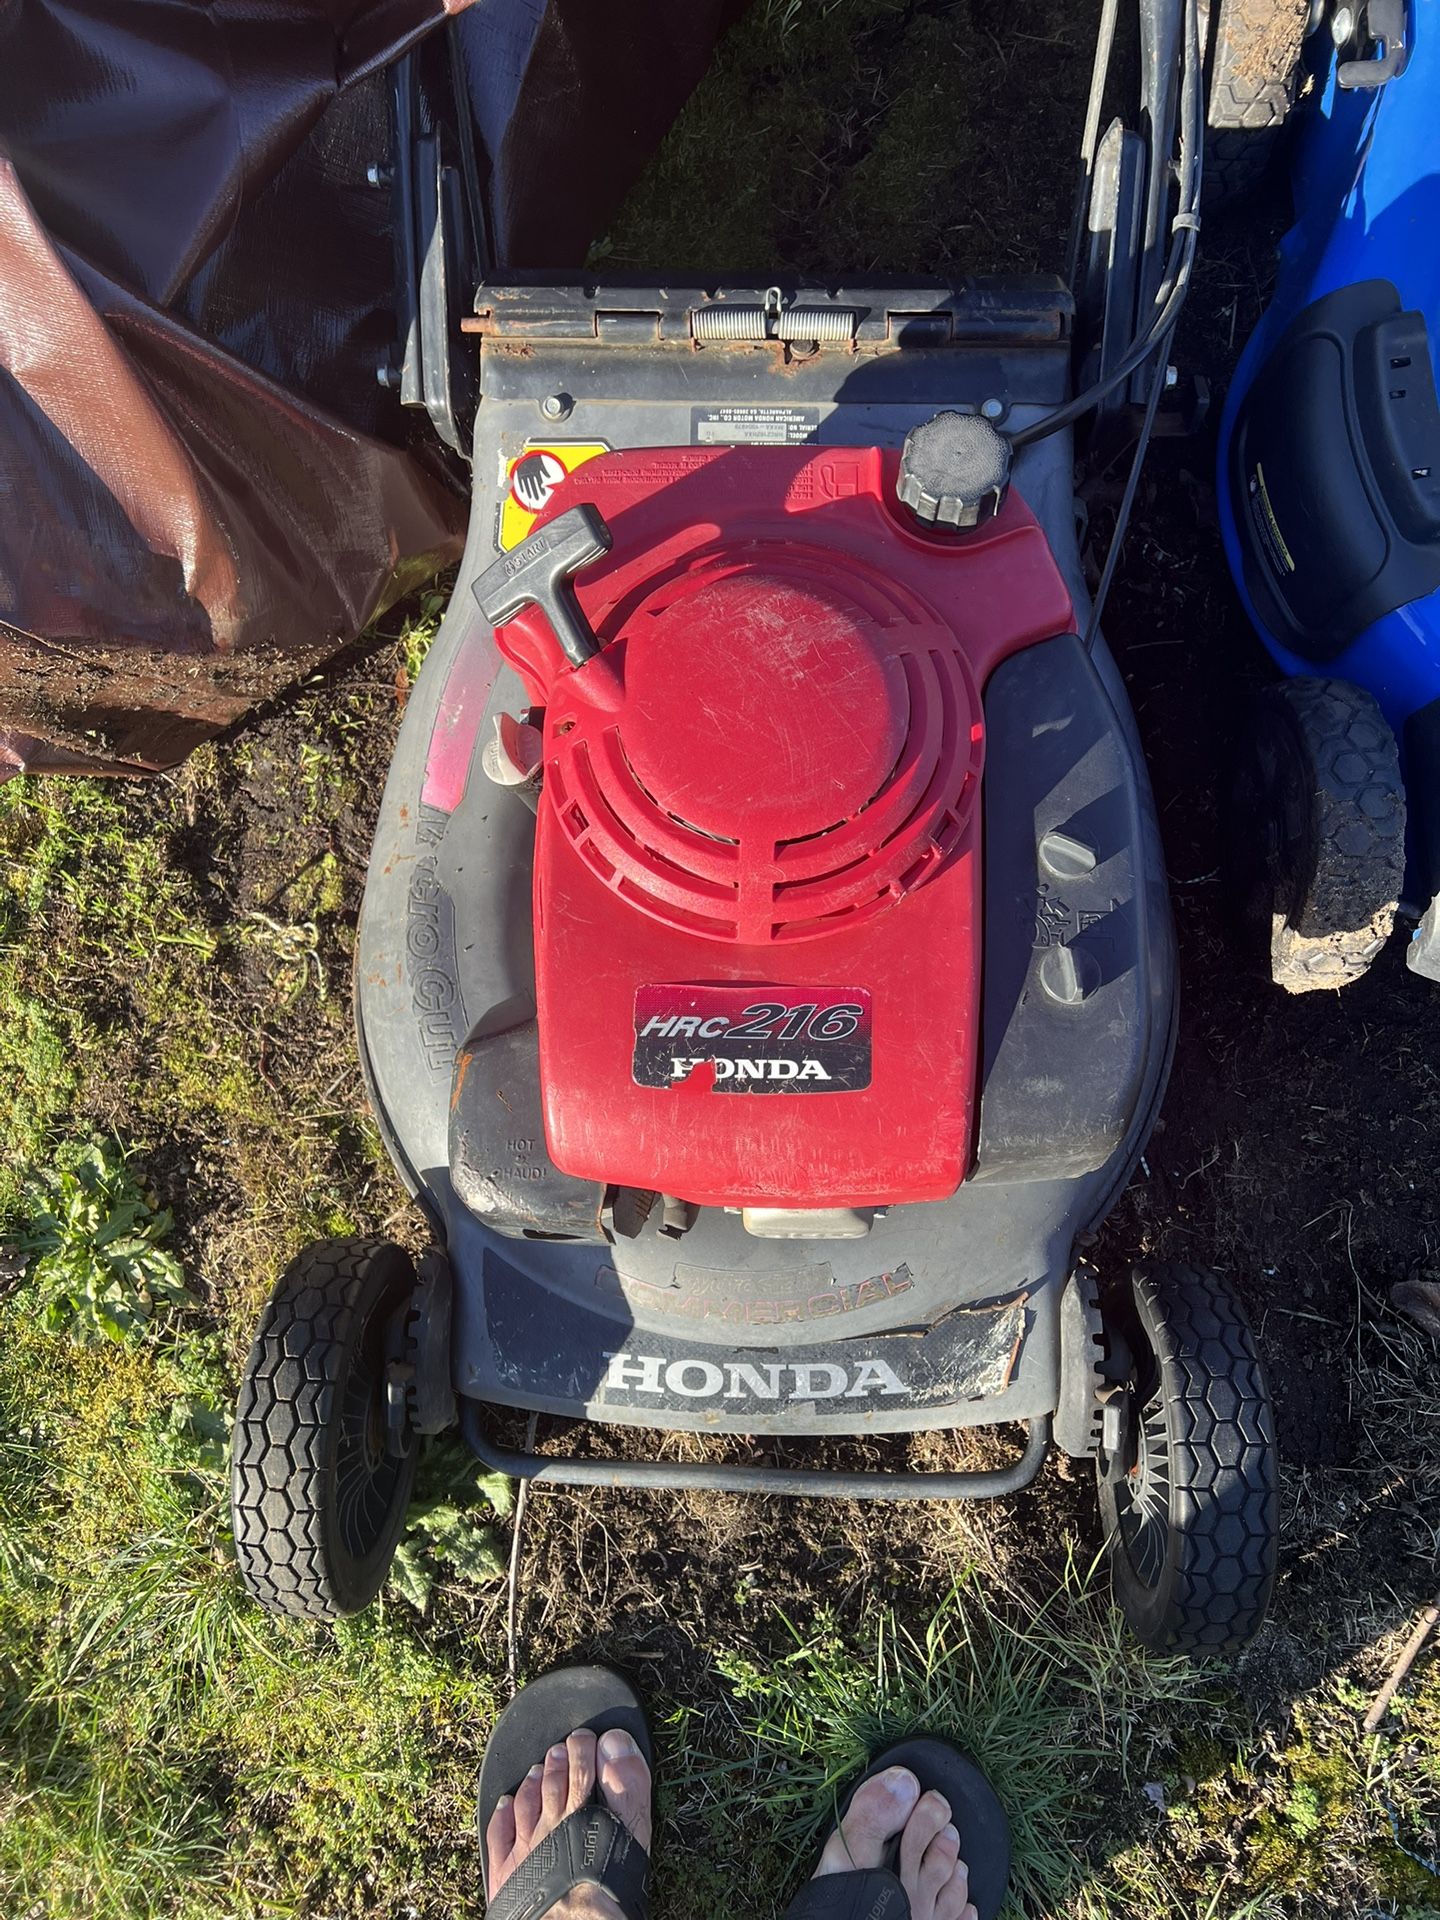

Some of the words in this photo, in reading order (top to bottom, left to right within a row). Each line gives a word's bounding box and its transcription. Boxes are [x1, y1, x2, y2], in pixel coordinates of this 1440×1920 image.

[512, 536, 545, 569] START
[670, 1057, 832, 1080] HONDA
[507, 1138, 536, 1152] HOT
[602, 1351, 911, 1399] HONDA
[583, 1821, 600, 1867] Flojos
